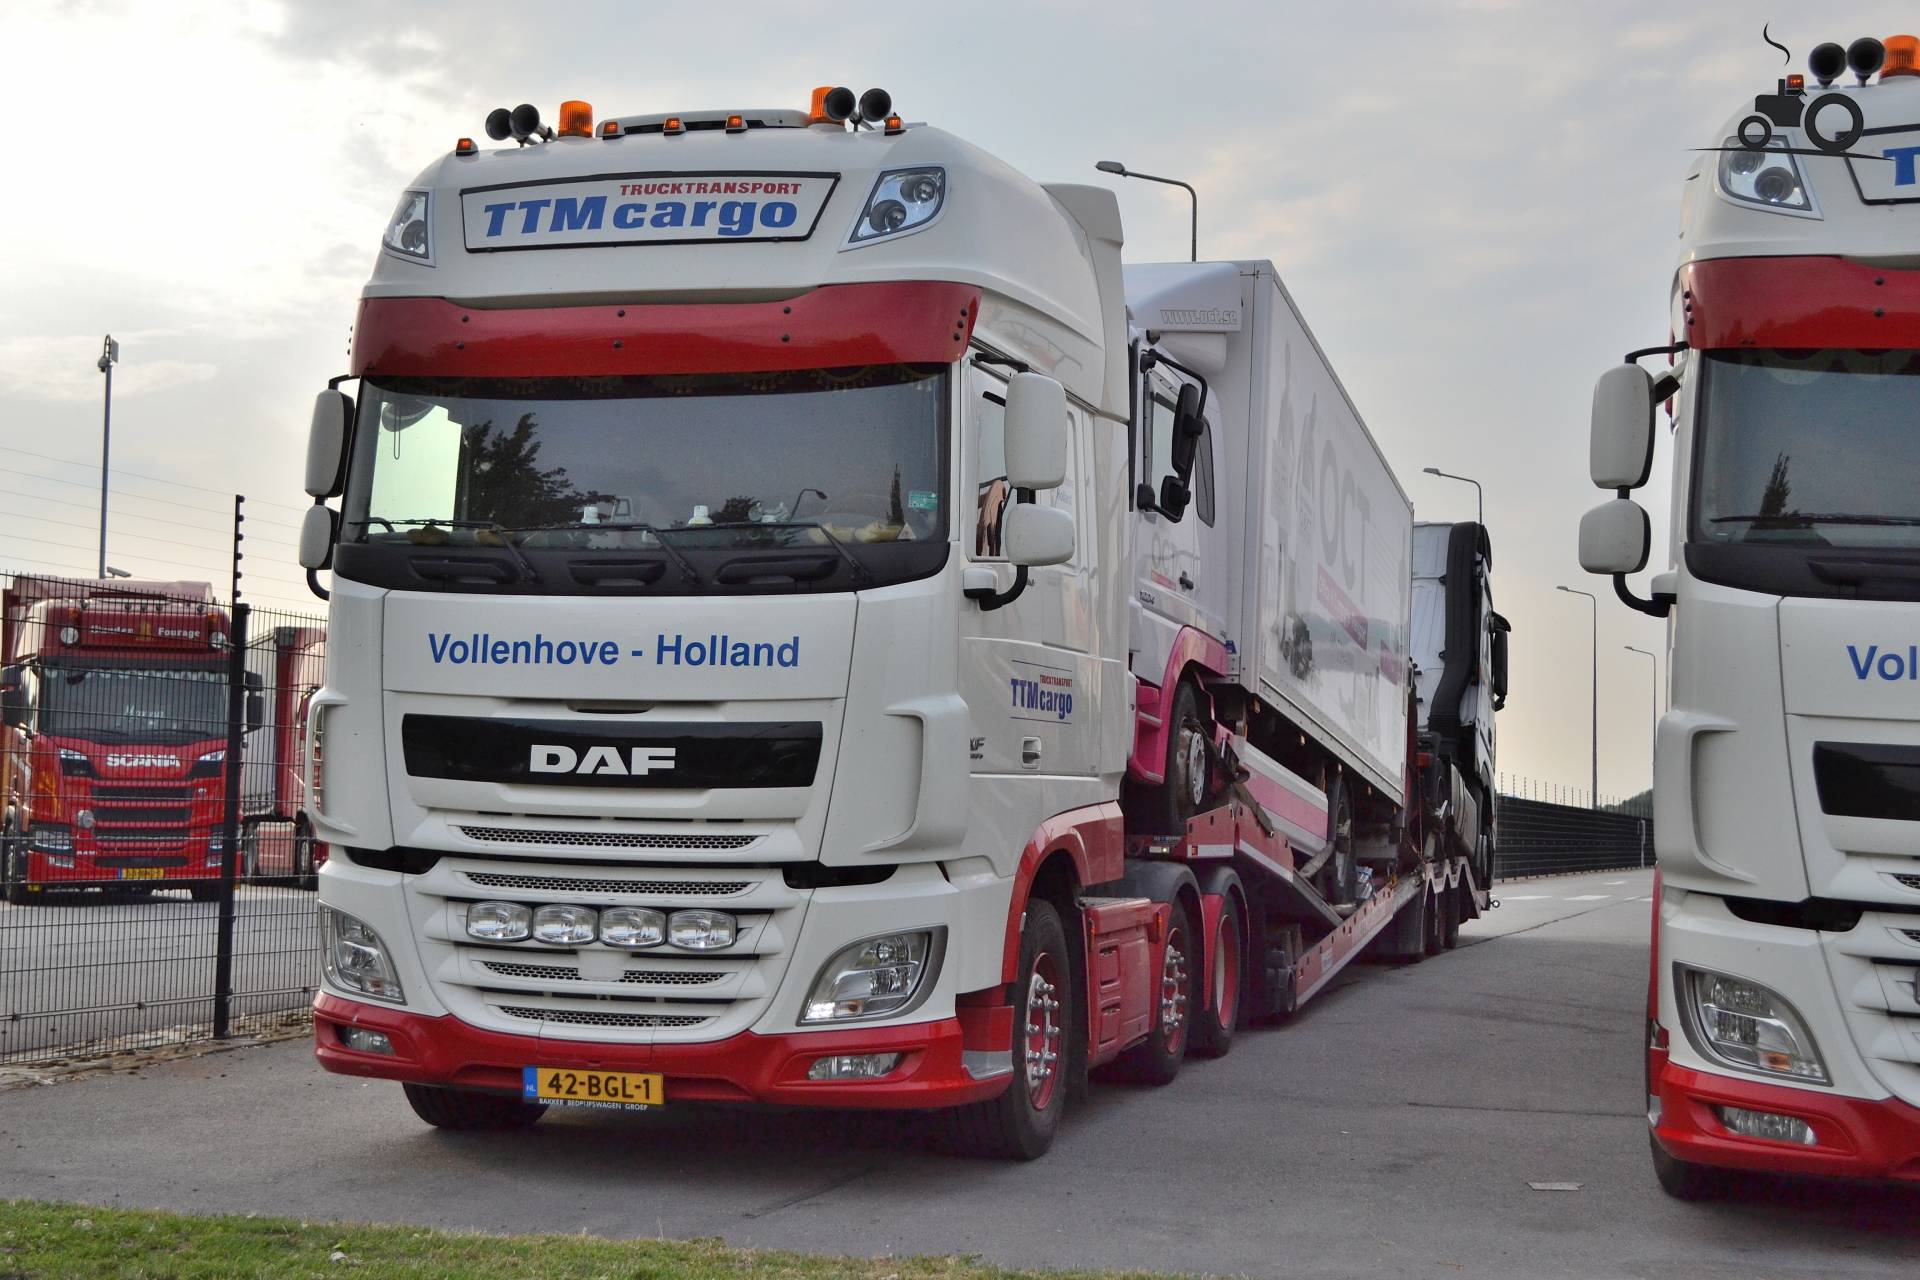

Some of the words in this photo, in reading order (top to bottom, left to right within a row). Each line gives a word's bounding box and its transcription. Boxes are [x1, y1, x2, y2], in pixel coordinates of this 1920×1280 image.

[620, 182, 802, 196] TRUCKTRANSPORT
[158, 626, 201, 639] Fourage
[428, 633, 620, 666] Vollenhove
[656, 634, 800, 668] Holland
[106, 752, 181, 768] SCANIA
[529, 744, 677, 776] DAF
[526, 1085, 537, 1093] NL
[547, 1072, 651, 1100] 42-BGL-1
[539, 1098, 565, 1106] BAKKER
[625, 1103, 648, 1111] GROEP
